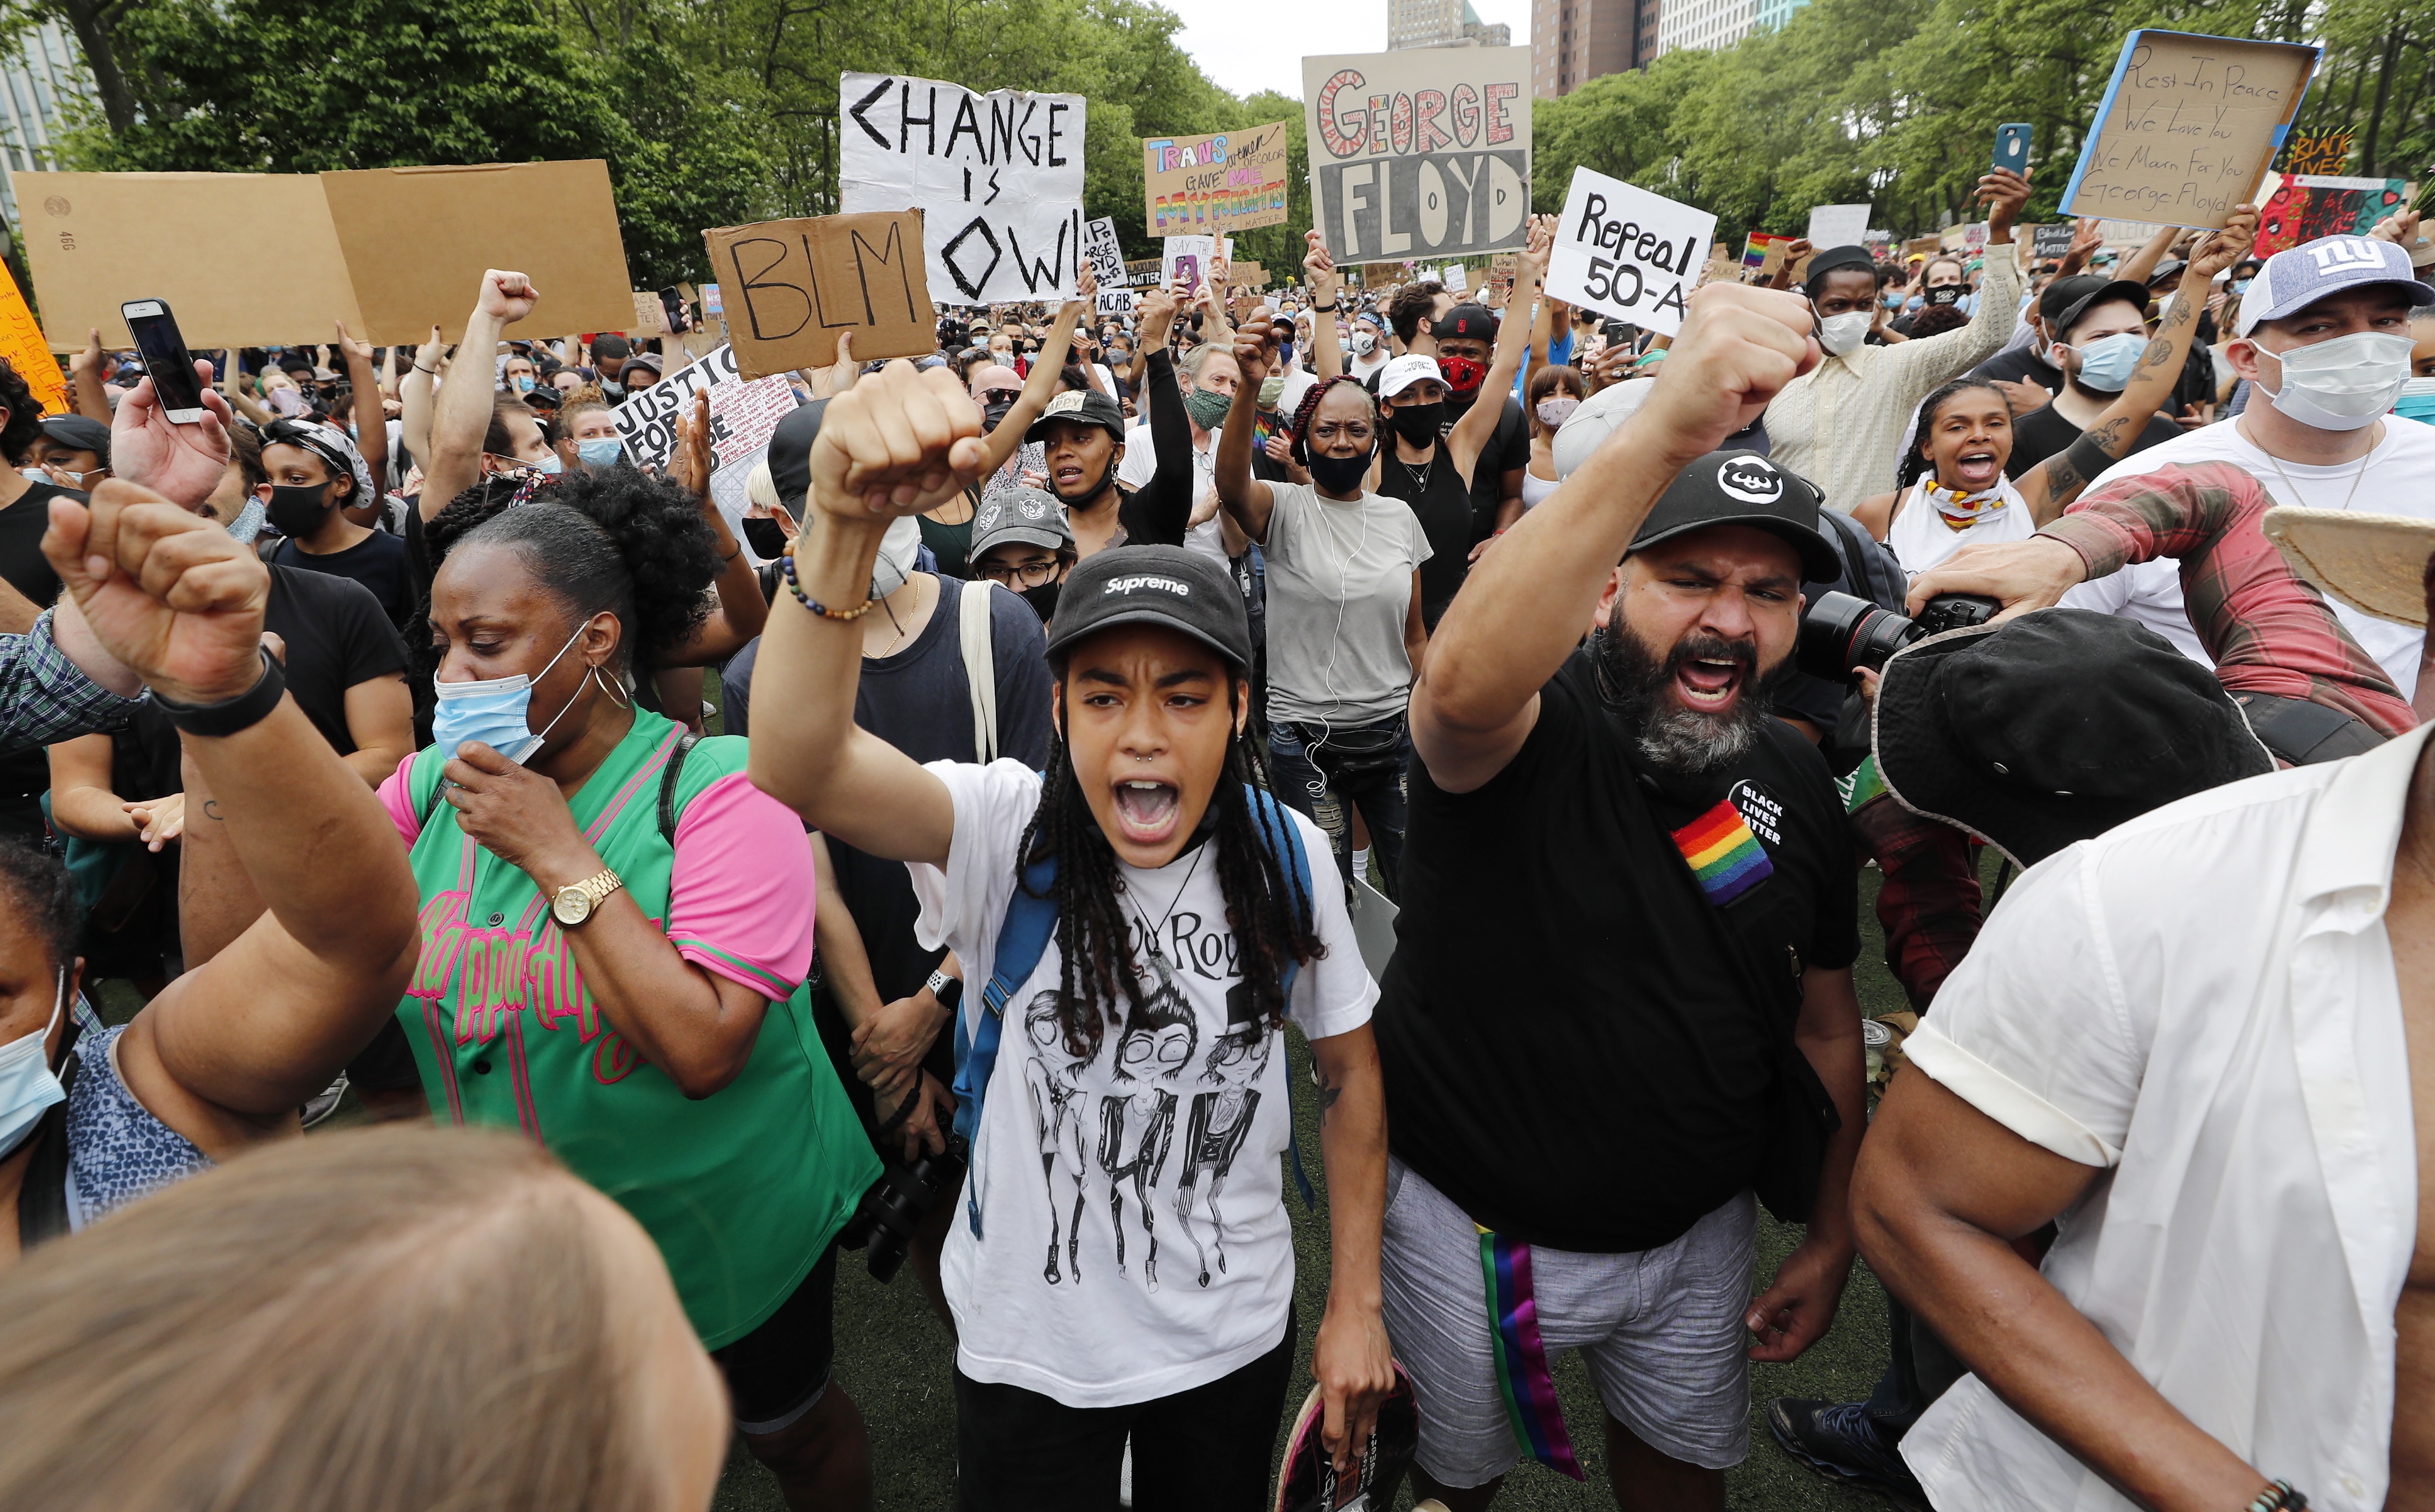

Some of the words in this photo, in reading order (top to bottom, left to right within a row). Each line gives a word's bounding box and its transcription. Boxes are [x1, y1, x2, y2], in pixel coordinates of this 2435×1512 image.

[2122, 46, 2177, 89] Rest
[2184, 57, 2215, 92] In
[2223, 65, 2279, 100] Peace
[849, 78, 1068, 167] CHANGE
[1317, 69, 1519, 158] GEORGE
[2125, 94, 2160, 131] We
[2167, 99, 2202, 136] Love
[2209, 105, 2232, 138] You
[1149, 135, 1227, 173] TRANS
[1221, 125, 1280, 173] women
[1244, 155, 1256, 167] OF
[1256, 149, 1286, 164] COLOR
[2092, 133, 2120, 170] We
[2216, 156, 2244, 183] You
[2293, 133, 2355, 163] BLACK
[2286, 157, 2348, 175] LIVES
[1186, 172, 1221, 191] GAVE
[1228, 166, 1263, 187] ME
[1156, 191, 1211, 228] MY
[1211, 179, 1286, 220] RIGHTS
[2078, 169, 2171, 212] George
[2177, 183, 2230, 219] Floyd
[1342, 155, 1523, 256] FLOYD
[1160, 226, 1188, 236] BLACK
[1246, 214, 1283, 228] MATTER
[1577, 192, 1697, 276] Repeal
[920, 208, 1081, 300] OW!
[1170, 238, 1190, 254] SAY
[1197, 240, 1213, 256] THE
[2034, 243, 2070, 254] MATTE
[1090, 256, 1116, 271] OYD
[1496, 258, 1512, 267] What
[1714, 265, 1735, 275] BLACK
[730, 221, 917, 340] BLM
[1129, 271, 1160, 286] MATTER
[1584, 256, 1684, 322] 50-A
[634, 295, 657, 304] ACK
[1099, 293, 1131, 311] ACAB
[1235, 297, 1263, 308] BLACK
[637, 313, 660, 323] TER
[704, 312, 722, 321] TONY
[615, 345, 738, 435] JUSTIC
[712, 382, 737, 400] TAYLOR
[713, 374, 737, 391] DIALLO
[743, 390, 761, 404] JONES
[776, 376, 786, 385] BELL
[712, 393, 734, 411] ARBERY
[735, 380, 759, 396] MICHAEL
[1047, 397, 1081, 410] APPY
[724, 408, 744, 422] WALTER
[746, 397, 762, 410] SCOTT
[734, 410, 764, 430] JEFFERSON
[748, 405, 760, 415] SEAN
[757, 411, 776, 425] CLAUDE
[718, 443, 735, 457] EZELL
[735, 433, 749, 444] FORD
[751, 421, 771, 435] GEORGE
[743, 438, 753, 447] HILL
[755, 429, 769, 439] TROY
[721, 445, 754, 466] CHRISTOPHER
[1105, 576, 1189, 597] Supreme
[1742, 785, 1783, 817] BLACK
[1742, 800, 1777, 828] LIVES
